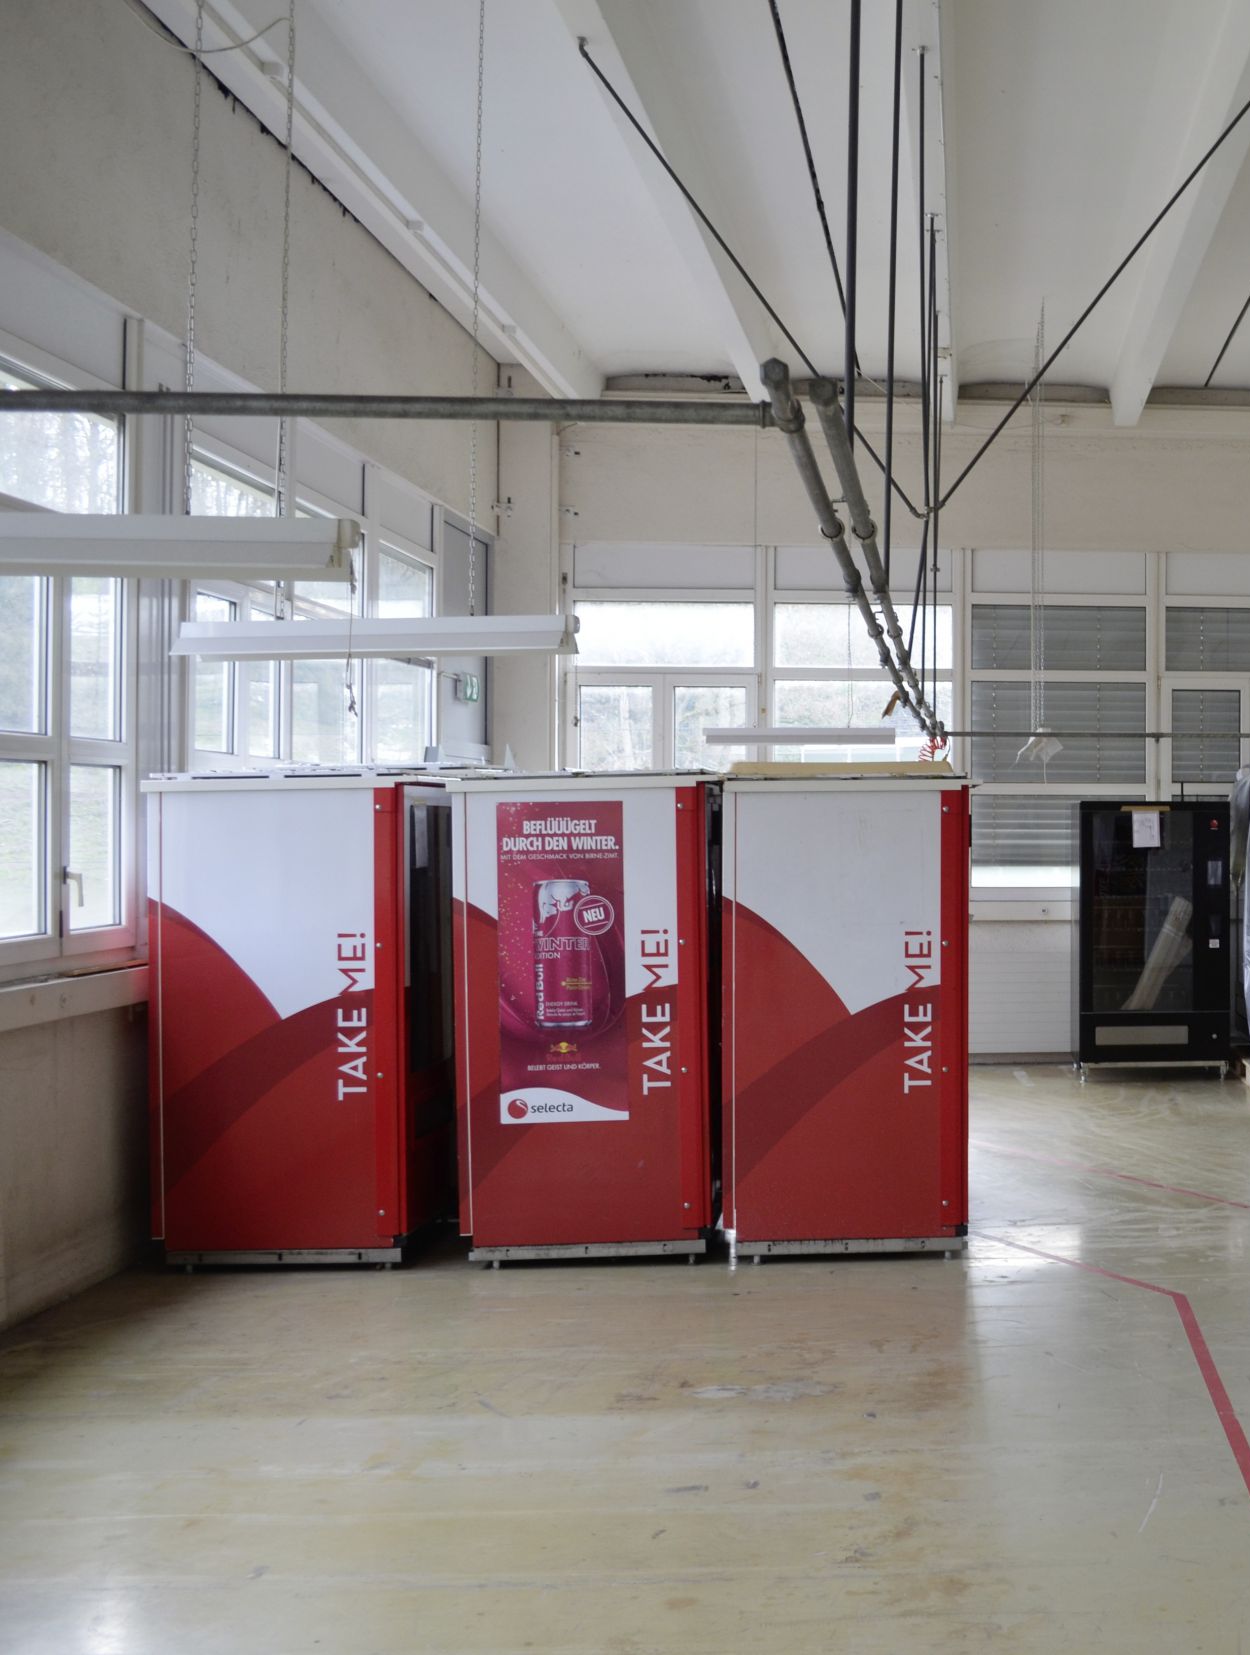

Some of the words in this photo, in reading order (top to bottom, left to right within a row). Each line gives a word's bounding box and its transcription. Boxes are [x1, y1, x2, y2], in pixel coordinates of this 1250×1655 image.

[502, 836, 542, 851] DURCH
[545, 836, 568, 850] DEN
[570, 835, 620, 850] WINTER.
[523, 817, 597, 834] BEFLÜÜÜGELT
[583, 907, 605, 923] NEU
[337, 932, 366, 996] ME!
[535, 963, 544, 990] Bull
[641, 929, 669, 992] ME!
[904, 930, 932, 992] ME!
[535, 992, 545, 1020] Red
[337, 1008, 367, 1101] TAKE
[641, 1003, 671, 1096] TAKE
[904, 1003, 932, 1094] TAKE
[530, 1102, 574, 1114] selecta
